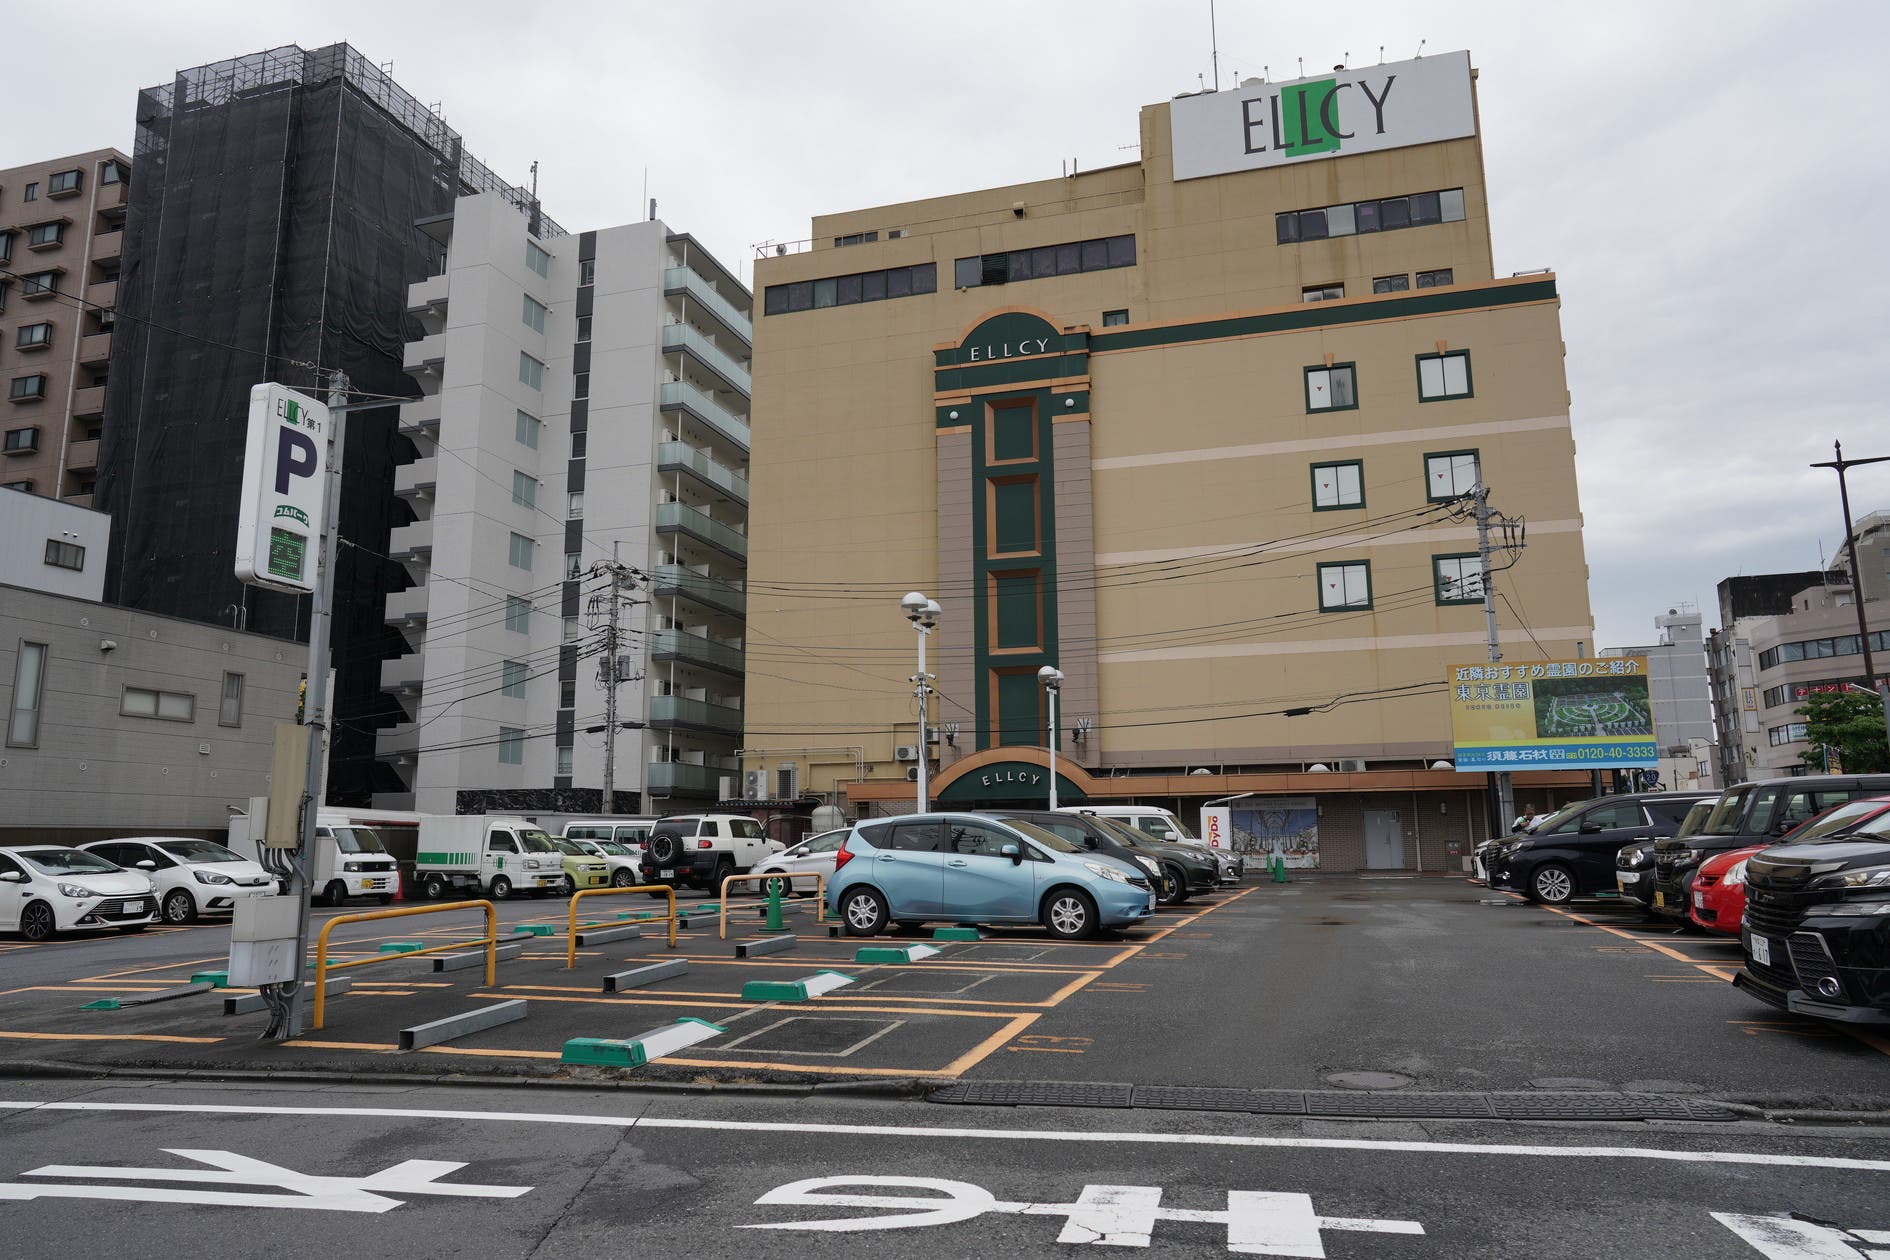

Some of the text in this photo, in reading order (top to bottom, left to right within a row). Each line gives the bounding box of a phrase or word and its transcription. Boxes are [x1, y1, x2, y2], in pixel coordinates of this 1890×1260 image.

[1241, 75, 1397, 155] ELLCY
[970, 338, 1049, 361] ELLCY
[277, 398, 309, 426] ELLCY
[275, 425, 318, 495] P
[1456, 660, 1640, 681] 近隣おすすめ霊園のご紹介
[1456, 682, 1530, 702] 東京霊園
[1577, 746, 1655, 760] 0120-40-3333
[982, 771, 1040, 786] ELLCY
[1210, 815, 1222, 848] DyDo
